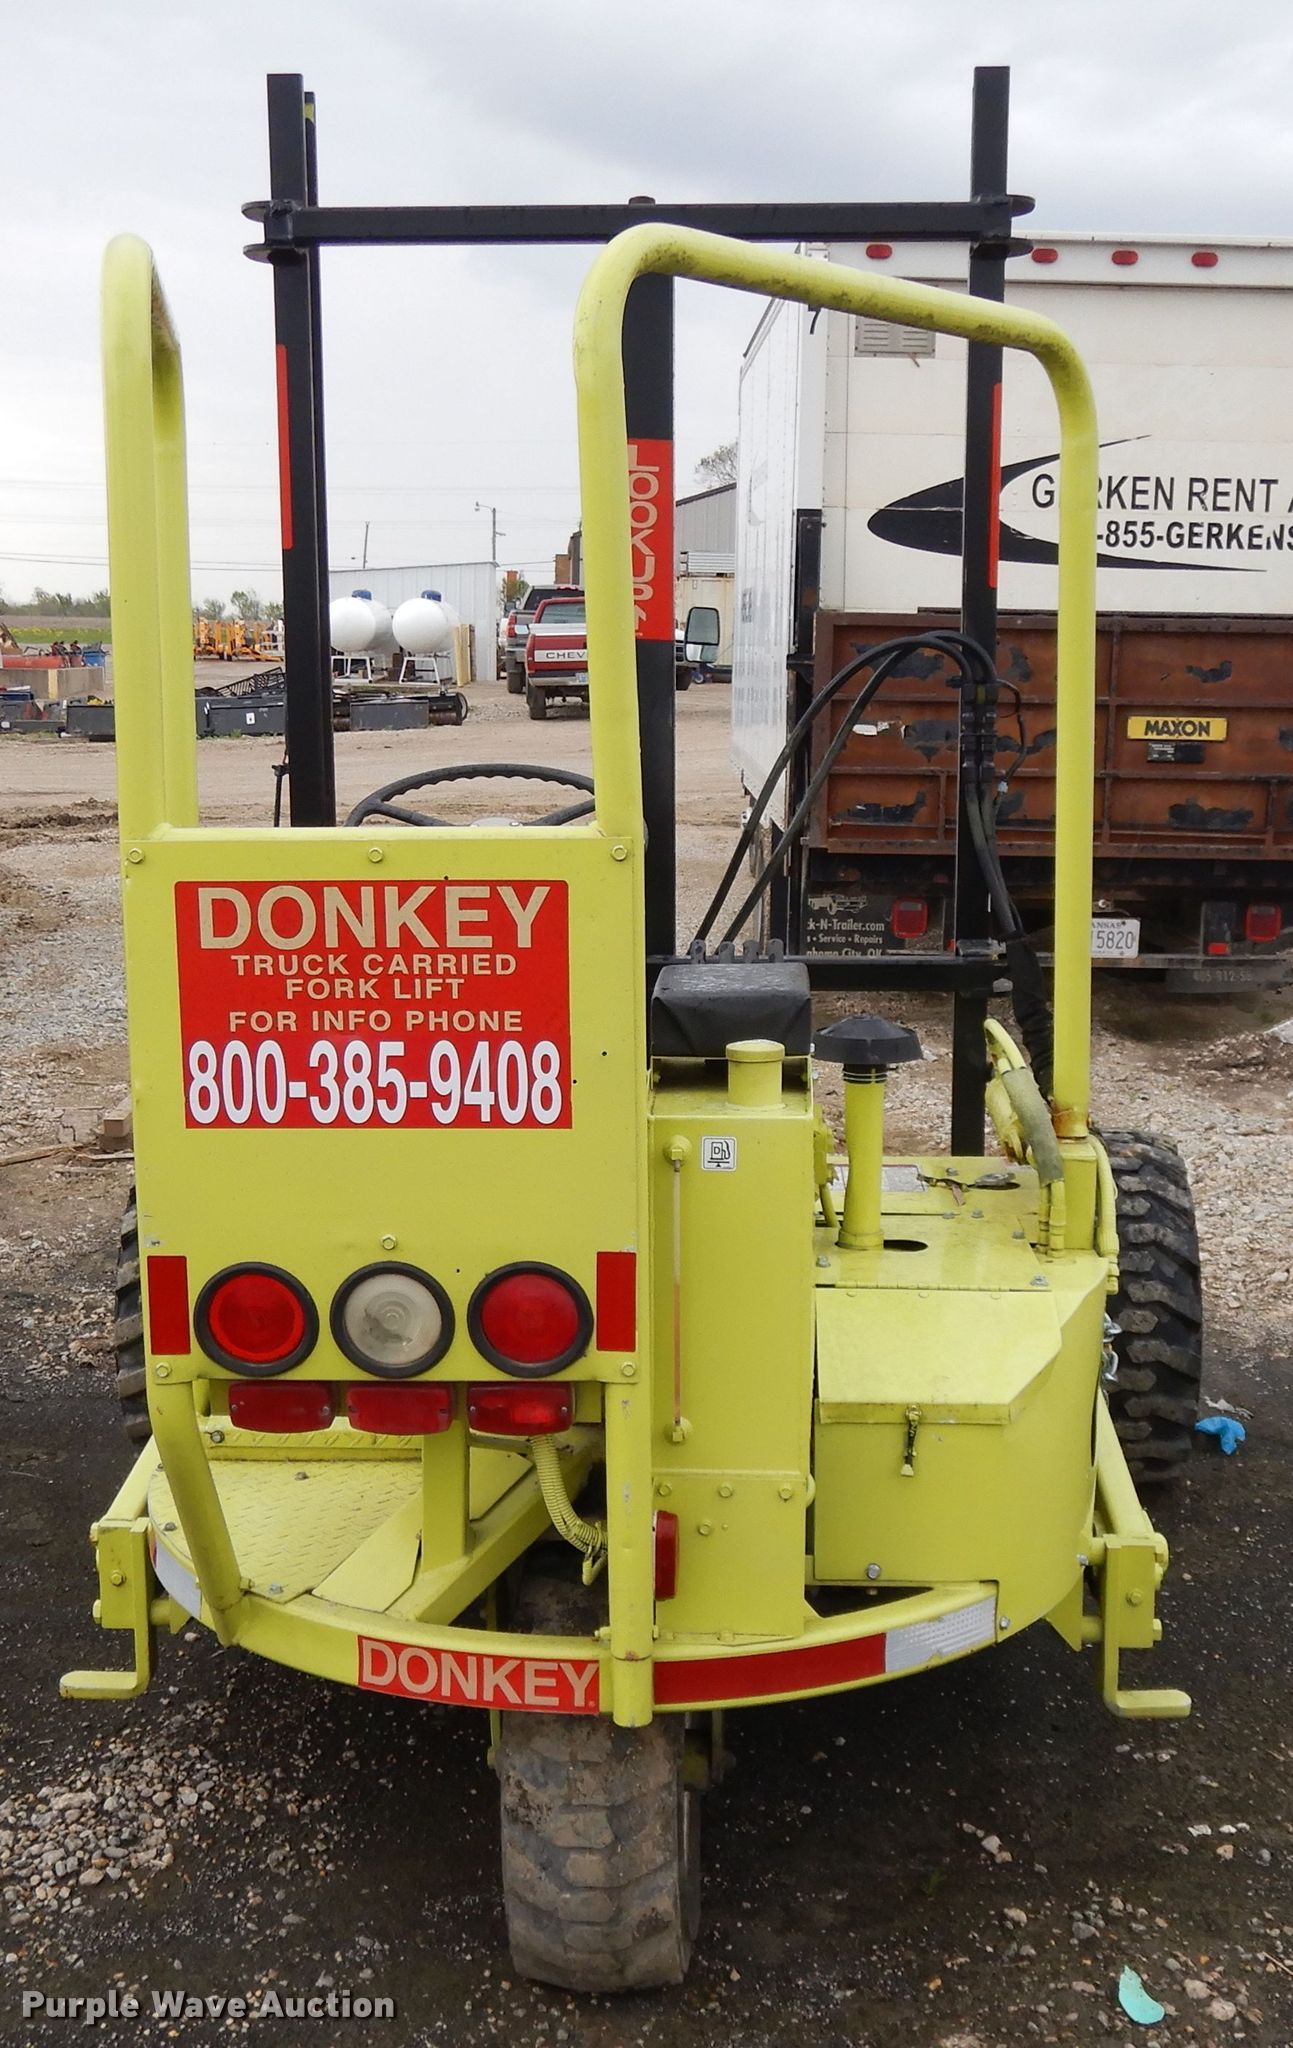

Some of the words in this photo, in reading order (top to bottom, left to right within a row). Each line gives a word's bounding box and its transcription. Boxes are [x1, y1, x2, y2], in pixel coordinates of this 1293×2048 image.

[1032, 473, 1175, 511] GKEN
[1187, 476, 1279, 513] RENT
[1096, 520, 1293, 550] -855-GERKEN
[546, 651, 586, 660] CHEV
[1144, 719, 1211, 737] MAXON
[197, 885, 552, 951] DONKEY
[807, 917, 885, 931] k-N-Trailer.com
[1092, 921, 1122, 929] ANSAS
[818, 933, 847, 944] Service
[853, 933, 883, 946] Repairs
[1091, 930, 1134, 950] 5820
[230, 954, 349, 977] TRUCK
[362, 953, 517, 976] CARRIED
[286, 978, 381, 1000] FORK
[393, 977, 466, 1000] LIFT
[228, 1010, 298, 1033] FOR
[312, 1009, 392, 1032] INFO
[405, 1009, 523, 1032] PHONE
[187, 1039, 563, 1125] 800-385-9408
[362, 1638, 600, 1707] DONKEY
